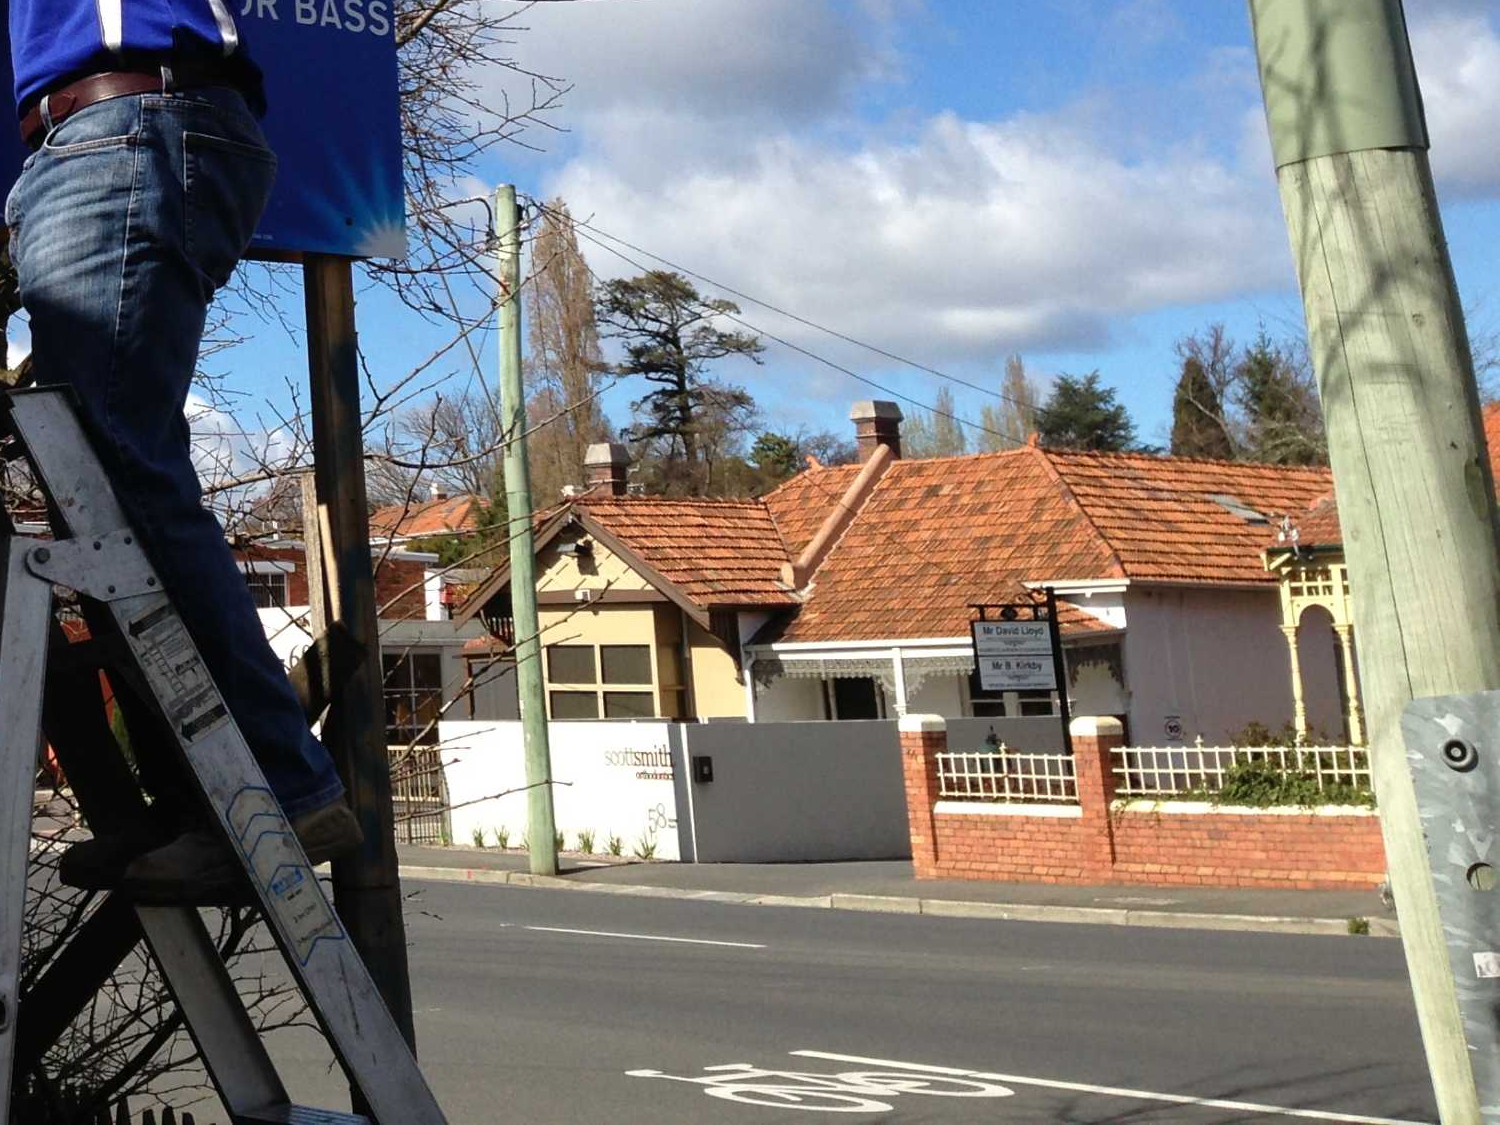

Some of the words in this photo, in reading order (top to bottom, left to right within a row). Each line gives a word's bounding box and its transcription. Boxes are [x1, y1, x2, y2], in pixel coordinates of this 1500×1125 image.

[996, 626, 1020, 636] David
[1021, 626, 1045, 639] Lloyd
[1016, 660, 1043, 673] Kirkby
[648, 802, 668, 834] 58
